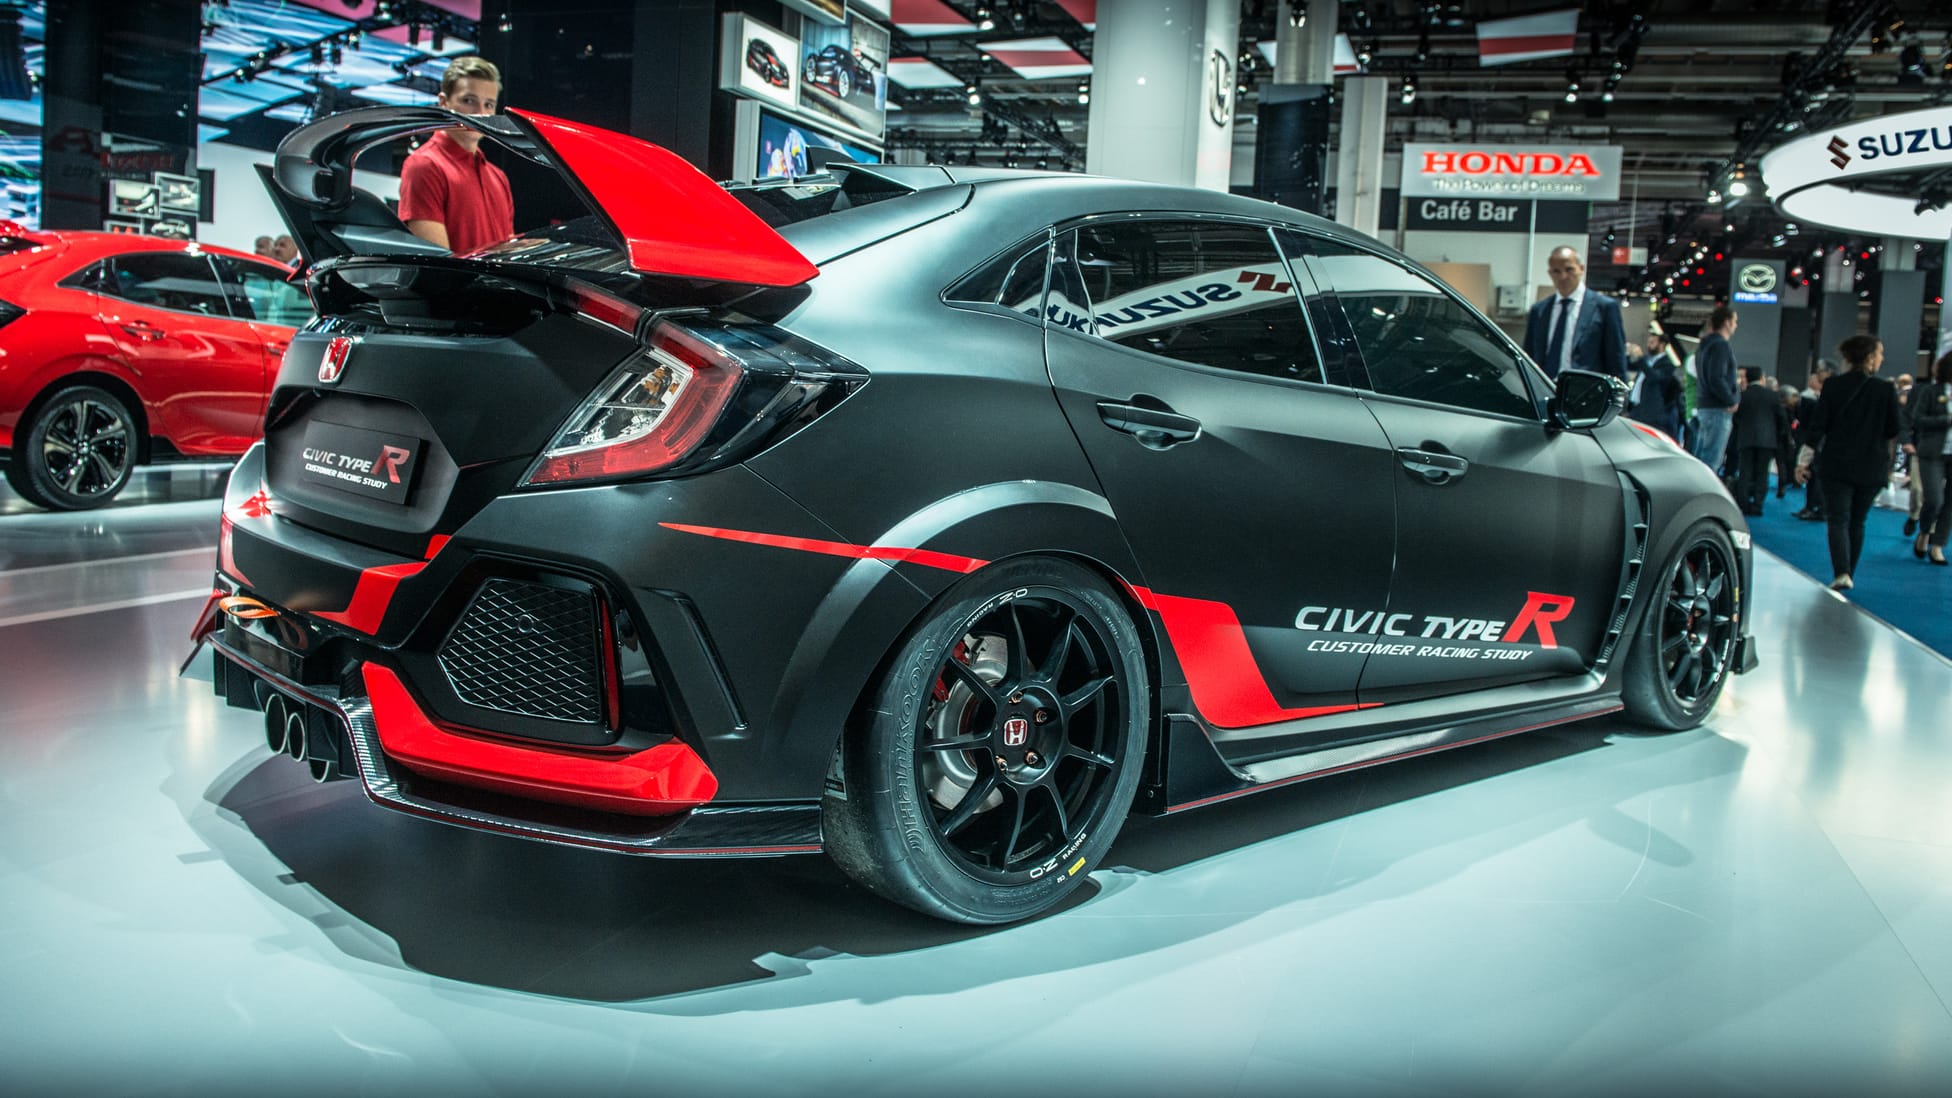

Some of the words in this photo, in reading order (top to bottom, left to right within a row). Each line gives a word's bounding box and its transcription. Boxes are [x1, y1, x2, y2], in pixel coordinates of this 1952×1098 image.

[1858, 125, 1952, 160] SUZU
[1421, 151, 1600, 176] HONDA
[1421, 200, 1471, 221] Café
[1478, 201, 1518, 222] Bar
[303, 447, 337, 465] CIVIC
[338, 454, 373, 474] TYPE
[371, 444, 411, 483] R
[305, 463, 338, 477] CUSTOMER
[337, 471, 362, 484] RACING
[362, 477, 388, 490] STUDY
[1294, 605, 1414, 637] CIVIC
[1419, 615, 1507, 642] TYPE
[1501, 590, 1575, 650] R
[1307, 639, 1415, 657] CUSTOMER
[1416, 645, 1480, 660] RACING
[1480, 649, 1534, 661] STUDY
[1061, 832, 1087, 860] RACING
